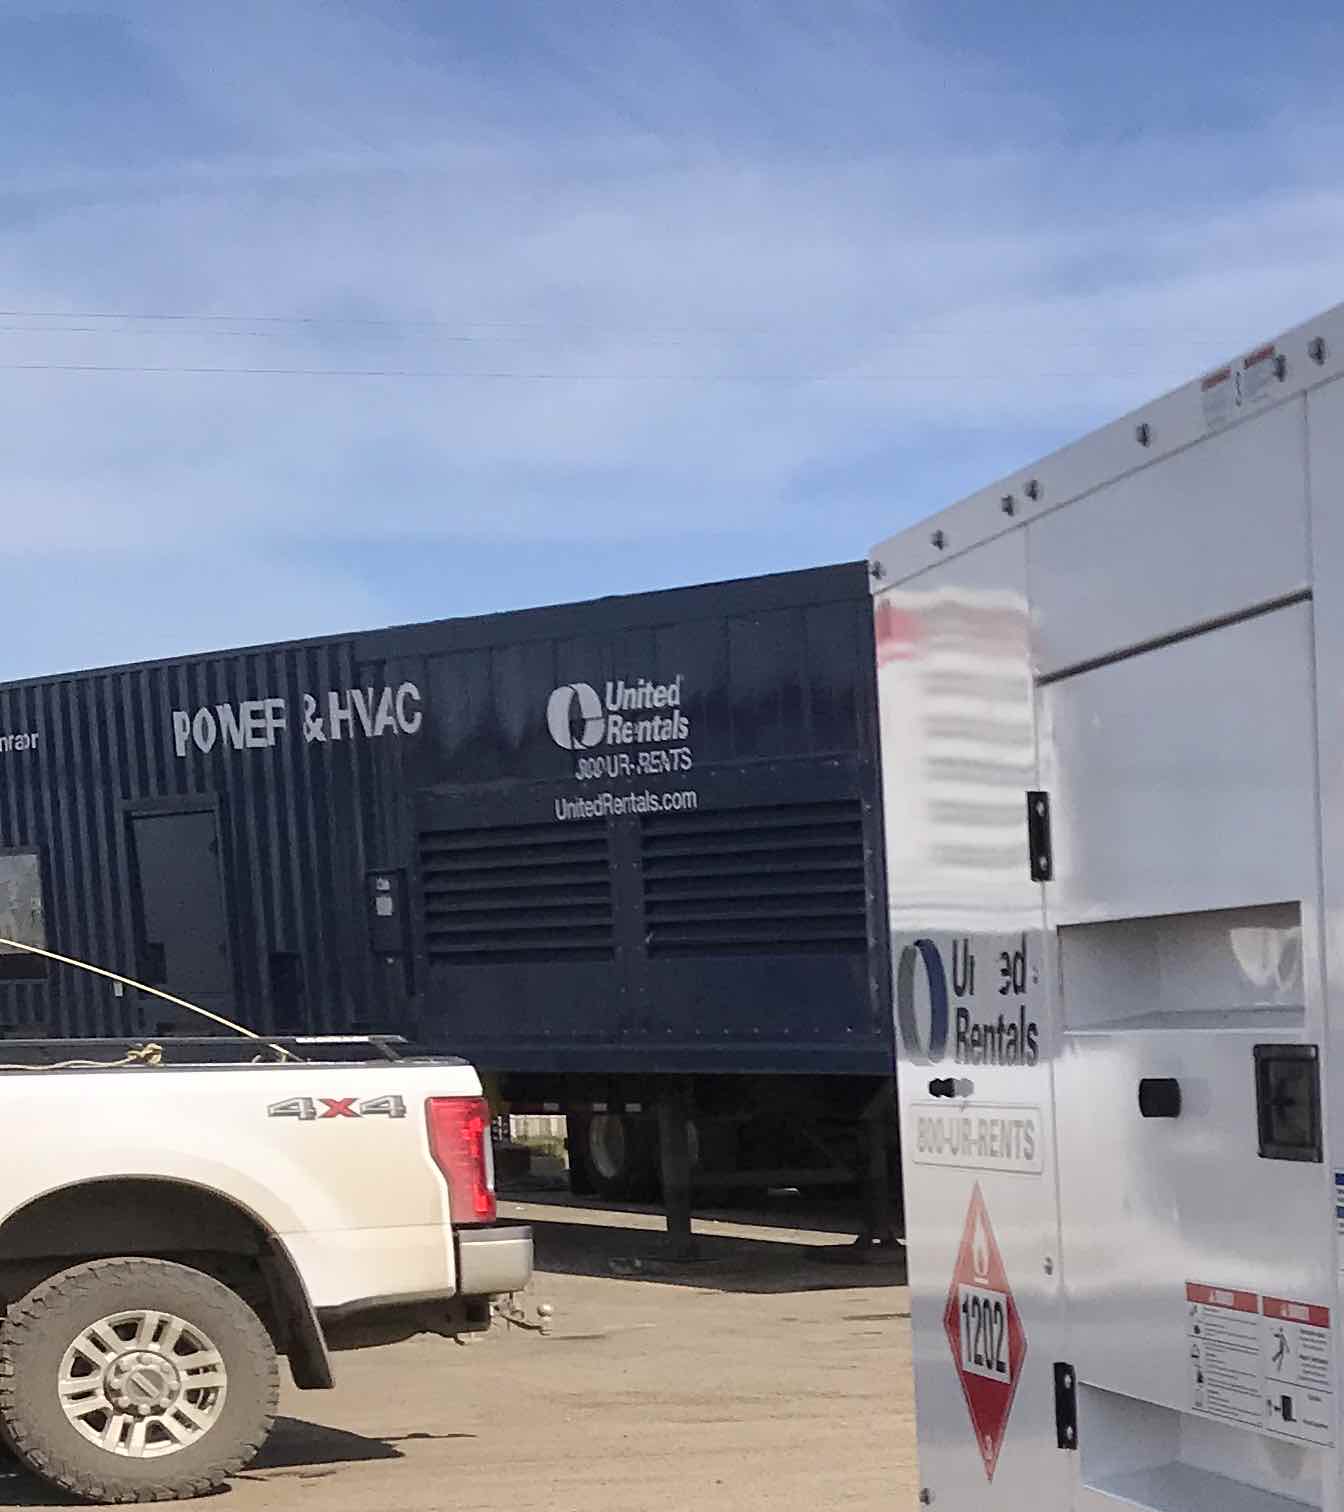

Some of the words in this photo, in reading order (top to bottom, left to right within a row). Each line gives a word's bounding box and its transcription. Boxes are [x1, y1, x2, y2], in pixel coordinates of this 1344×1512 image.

[302, 693, 327, 744] &
[327, 681, 422, 743] HVAC
[605, 673, 682, 711] United
[607, 709, 689, 746] Rentals
[575, 746, 693, 781] 800UR-RENTS
[554, 789, 699, 822] UnitedRentals.com
[953, 1004, 1041, 1067] Rentals
[915, 1116, 1036, 1161] 800-UR-RENTS
[961, 1294, 1008, 1374] 1202
